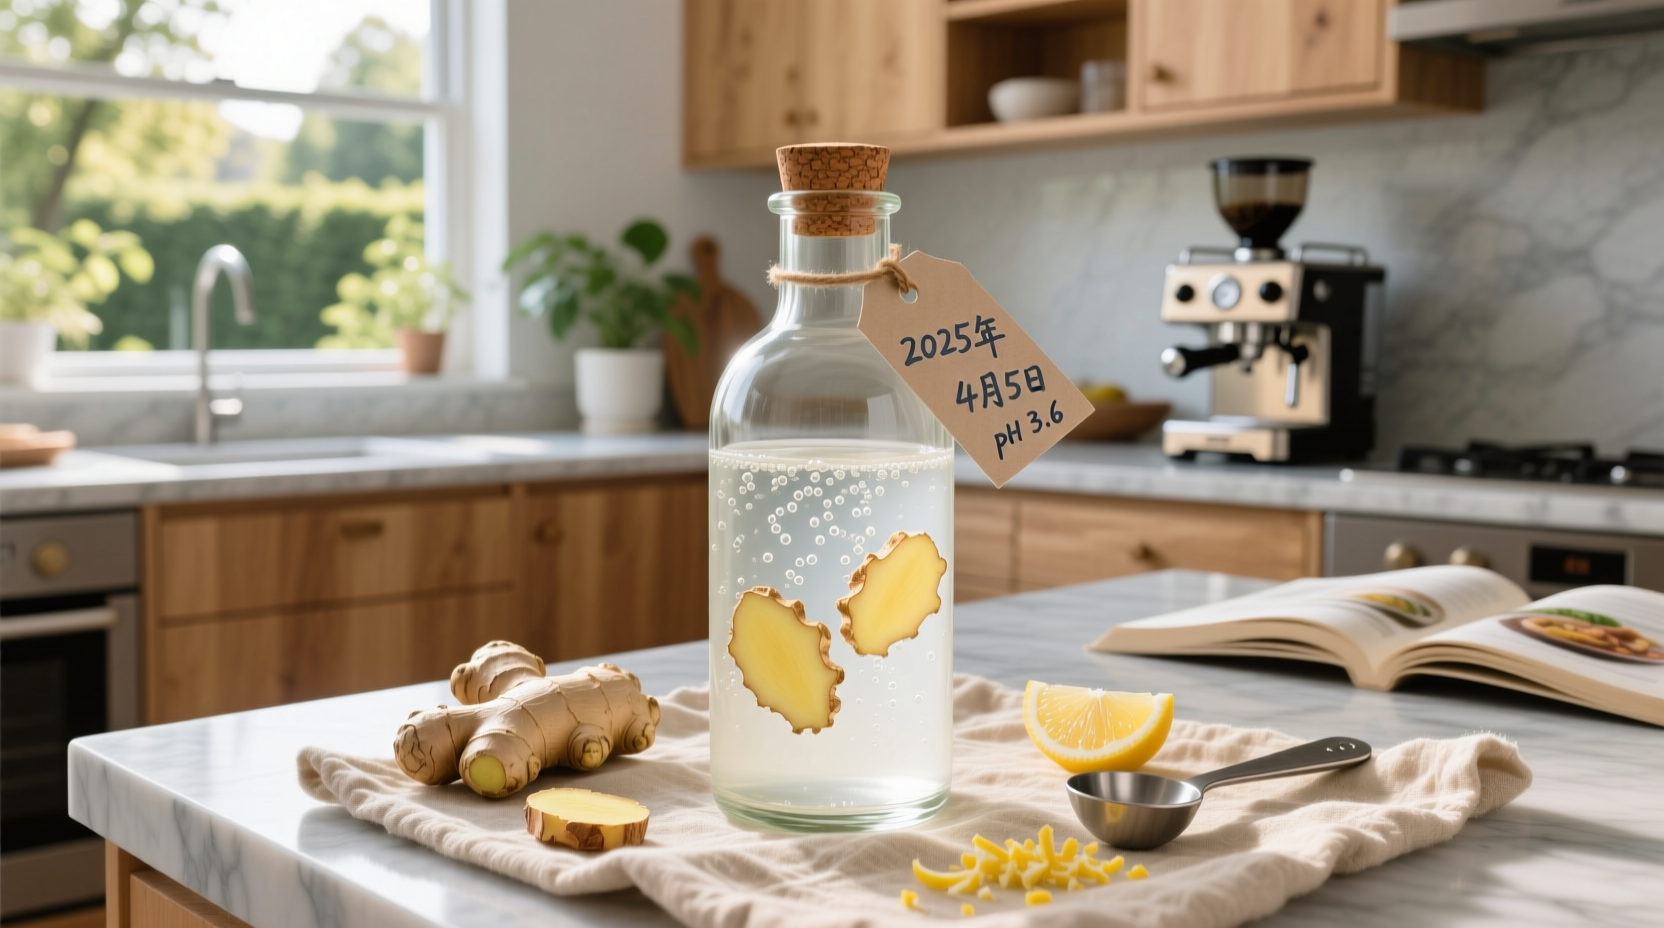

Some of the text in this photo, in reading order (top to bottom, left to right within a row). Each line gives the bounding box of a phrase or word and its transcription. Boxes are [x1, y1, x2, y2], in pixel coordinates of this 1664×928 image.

[900, 315, 1006, 367] 2025年
[955, 365, 1045, 412] 4月5日
[994, 400, 1064, 460] pH 3.6
